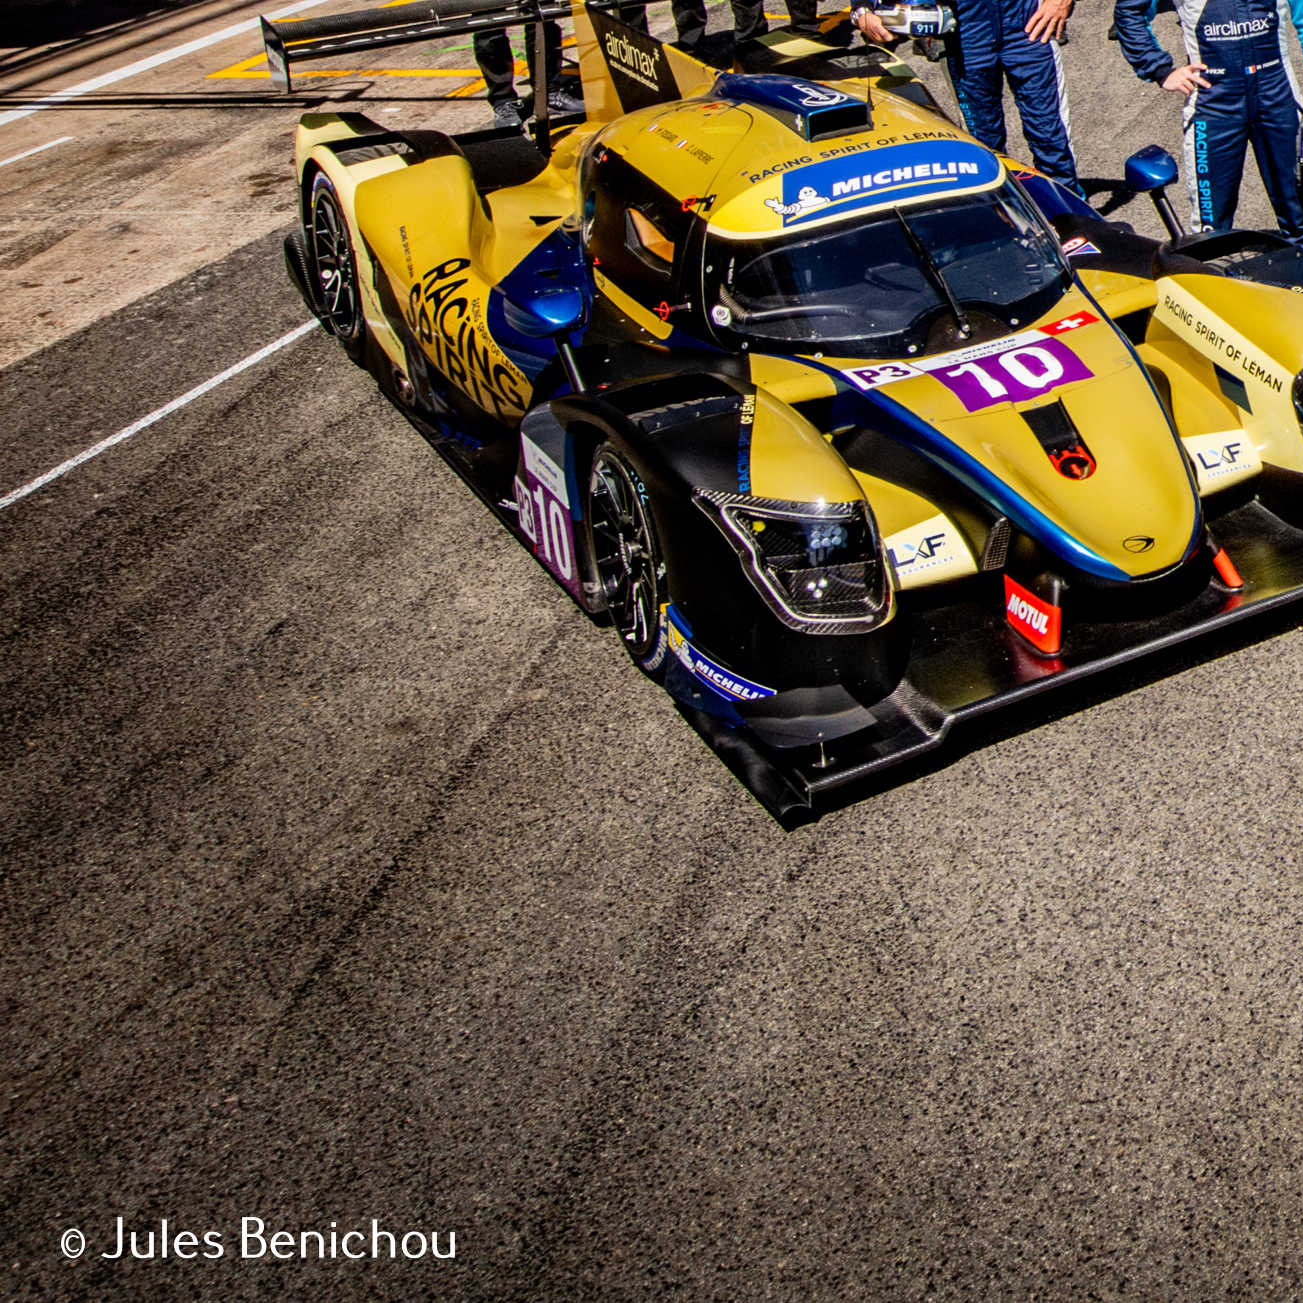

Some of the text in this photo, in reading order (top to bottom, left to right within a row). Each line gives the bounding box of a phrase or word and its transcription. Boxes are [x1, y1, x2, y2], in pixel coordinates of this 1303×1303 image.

[916, 23, 935, 34] 911
[749, 155, 813, 185] RACING
[819, 141, 872, 160] SPIRIT
[876, 136, 897, 147] OF
[832, 161, 979, 197] MICHELIN
[1194, 120, 1214, 223] RACING SPIRIT
[422, 257, 530, 413] RACING
[1164, 295, 1193, 327] RACING
[1195, 320, 1226, 351] SPIRIT
[1225, 344, 1242, 361] OF
[851, 364, 912, 385] P3
[945, 346, 1065, 399] 10
[532, 485, 573, 581] 10
[1007, 592, 1050, 635] MOTUL
